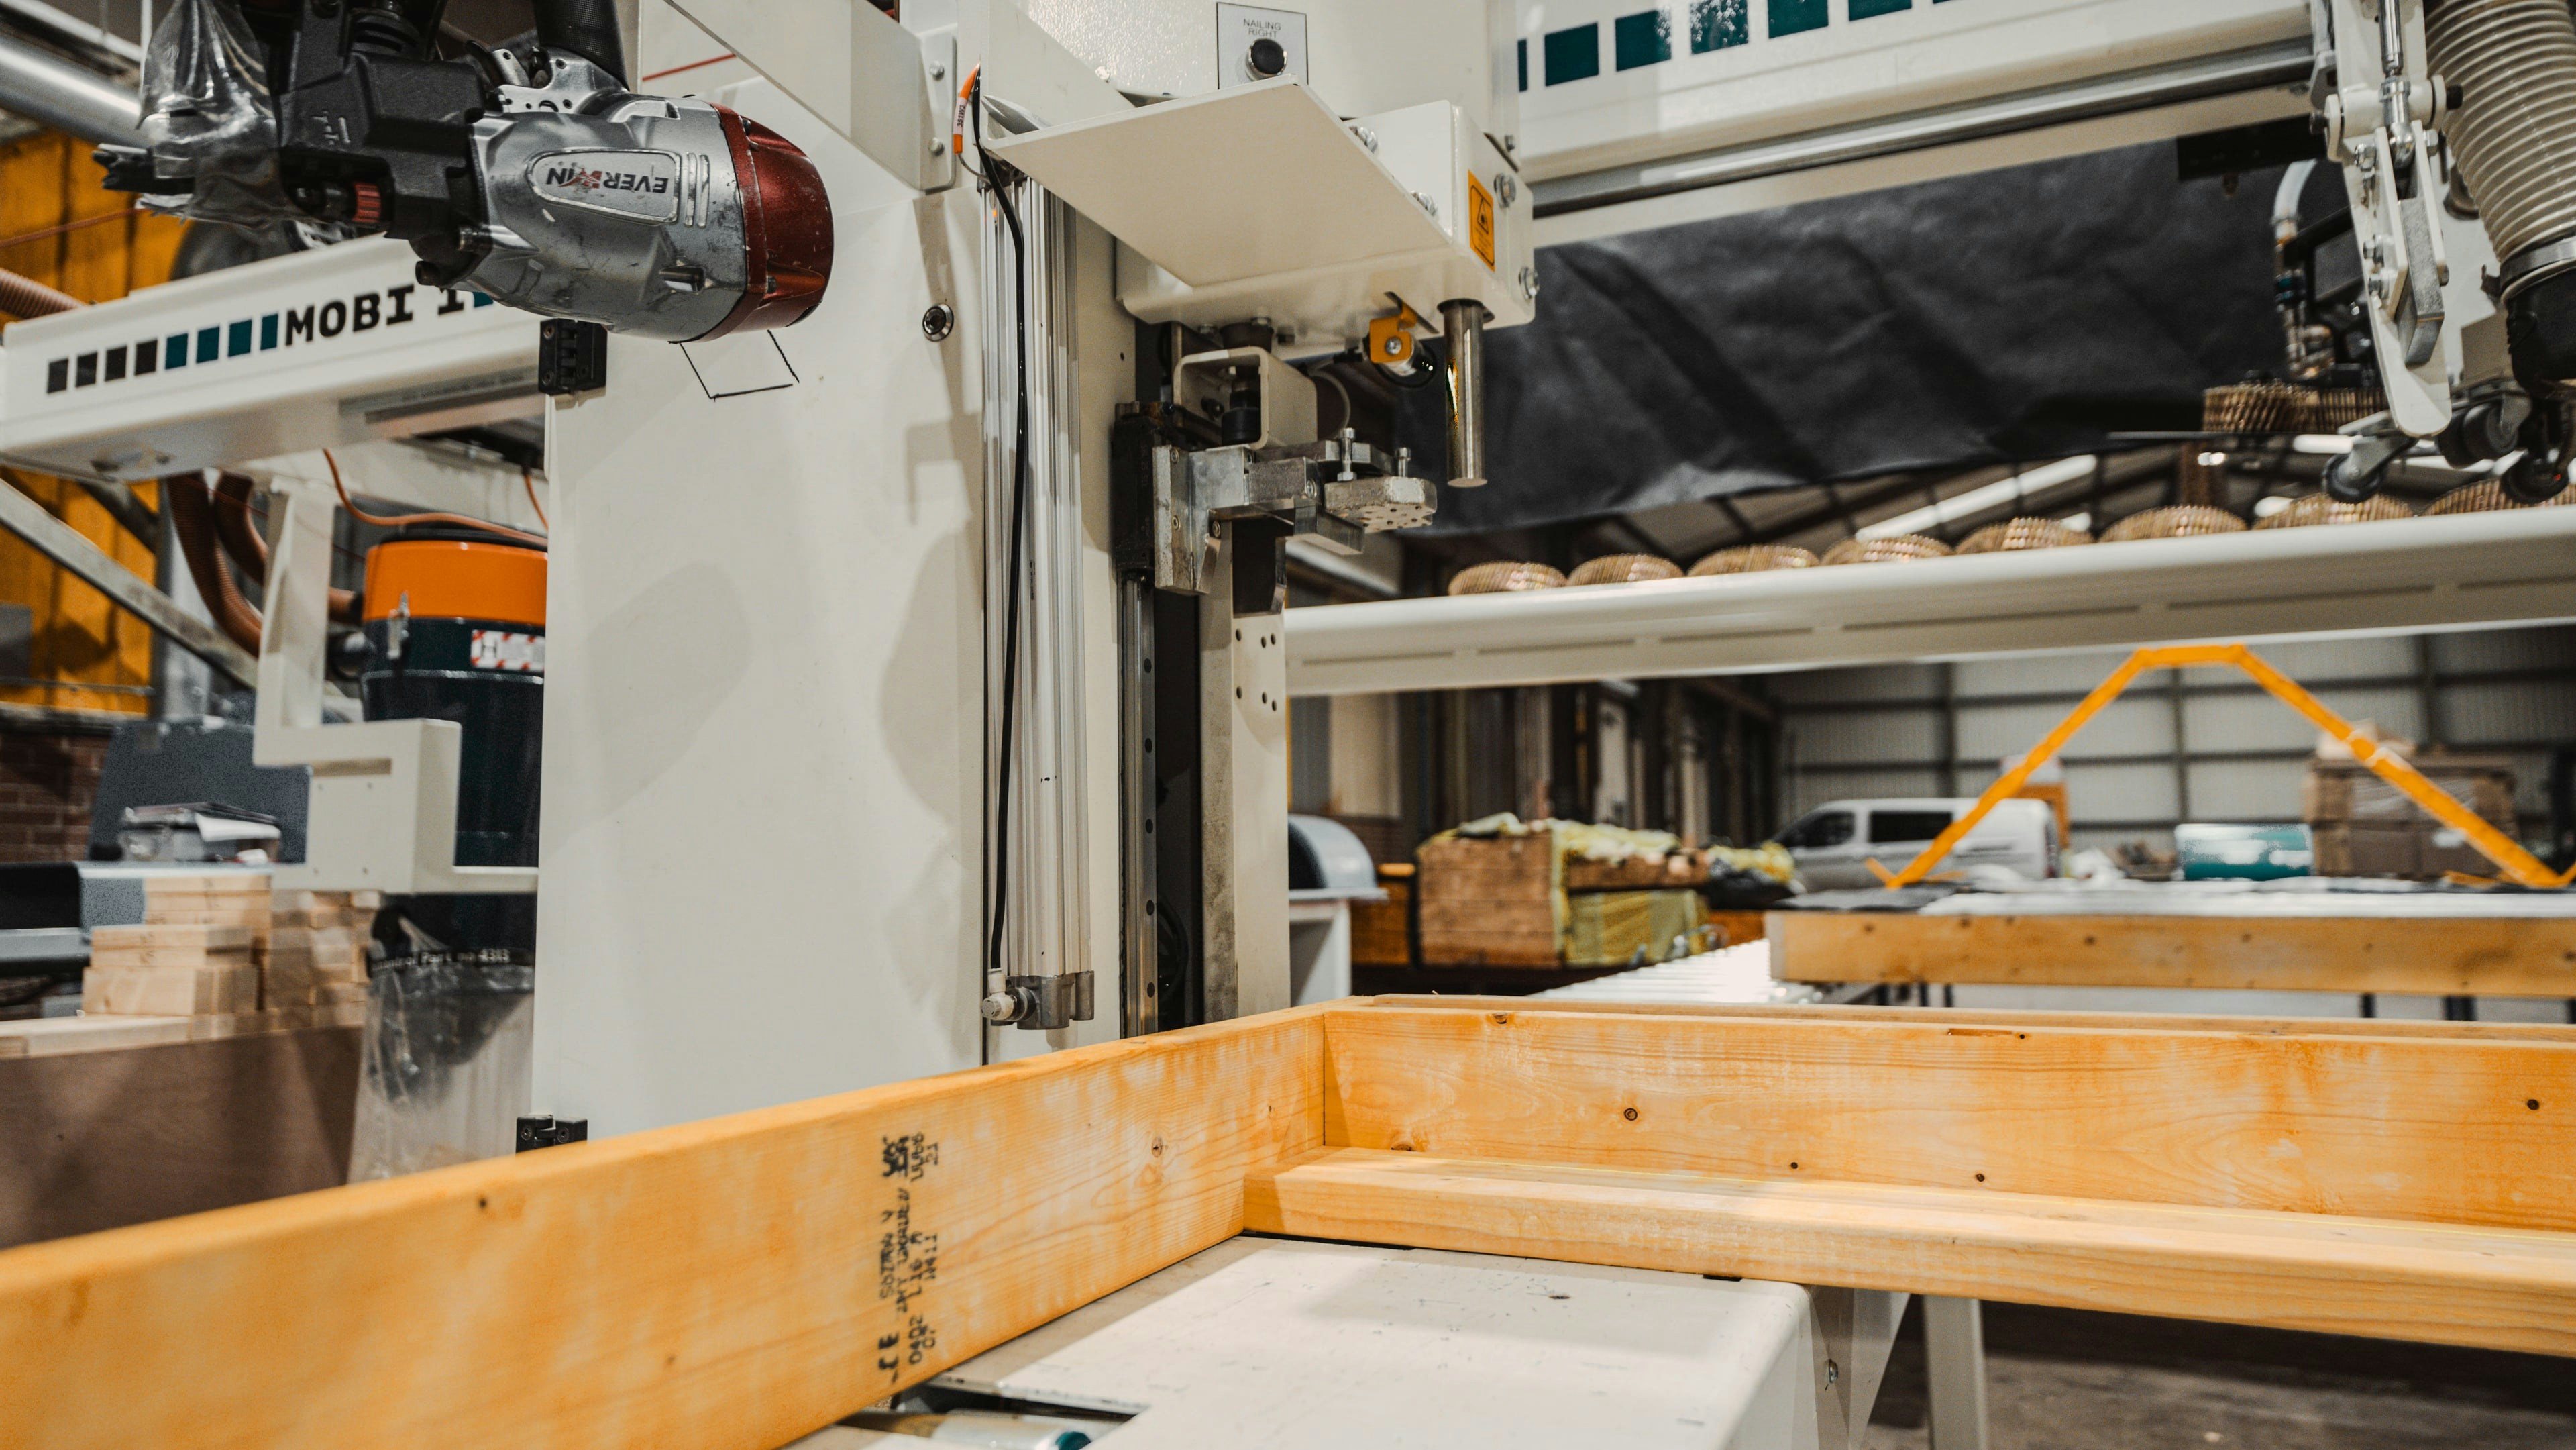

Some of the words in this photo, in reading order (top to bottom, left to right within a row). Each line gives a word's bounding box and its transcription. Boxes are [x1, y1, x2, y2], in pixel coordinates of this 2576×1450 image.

[1243, 18, 1282, 31] NAILING
[1248, 27, 1278, 38] RIGHT
[957, 104, 965, 128] 351W3
[284, 284, 415, 347] MOBI
